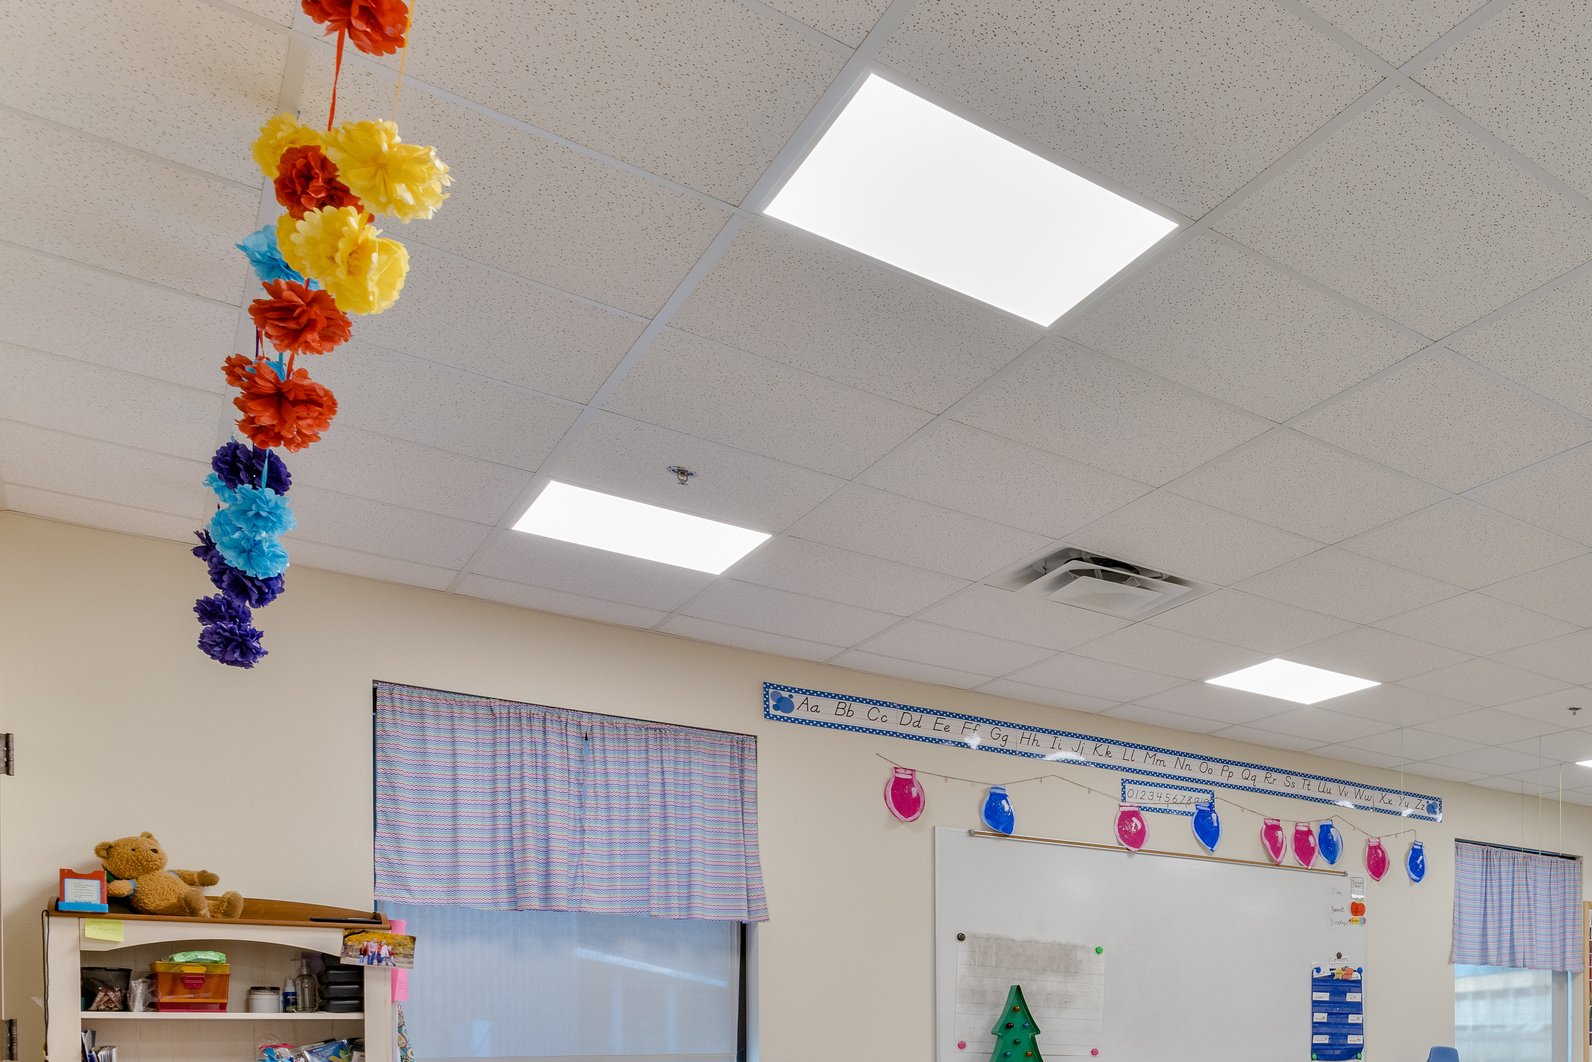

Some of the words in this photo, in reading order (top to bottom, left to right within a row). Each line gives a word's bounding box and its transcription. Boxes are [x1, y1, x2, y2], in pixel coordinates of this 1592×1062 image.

[797, 697, 821, 714] Aa
[834, 702, 855, 718] Bb
[866, 707, 888, 723] Cc
[899, 712, 922, 729] Dd
[932, 717, 951, 733] Ee
[990, 727, 1009, 747] Gg
[1019, 731, 1041, 747] Hh
[1050, 736, 1063, 750] Ii
[1071, 740, 1085, 756] Jj
[1093, 744, 1113, 759] Kk
[1122, 748, 1136, 763] Ll
[1143, 752, 1167, 768] Mm
[1174, 757, 1192, 772] Nn
[1199, 761, 1213, 776] Oo
[1220, 765, 1234, 781] Pp
[1241, 768, 1257, 786] Qq
[1263, 772, 1277, 785] Rr
[1284, 776, 1296, 790] Ss
[1300, 779, 1312, 792] Tt
[1317, 782, 1332, 796] Uu
[1337, 785, 1350, 797] Vv
[1353, 788, 1373, 802] Ww
[1379, 792, 1393, 806] Xx
[1414, 799, 1425, 811] Zz
